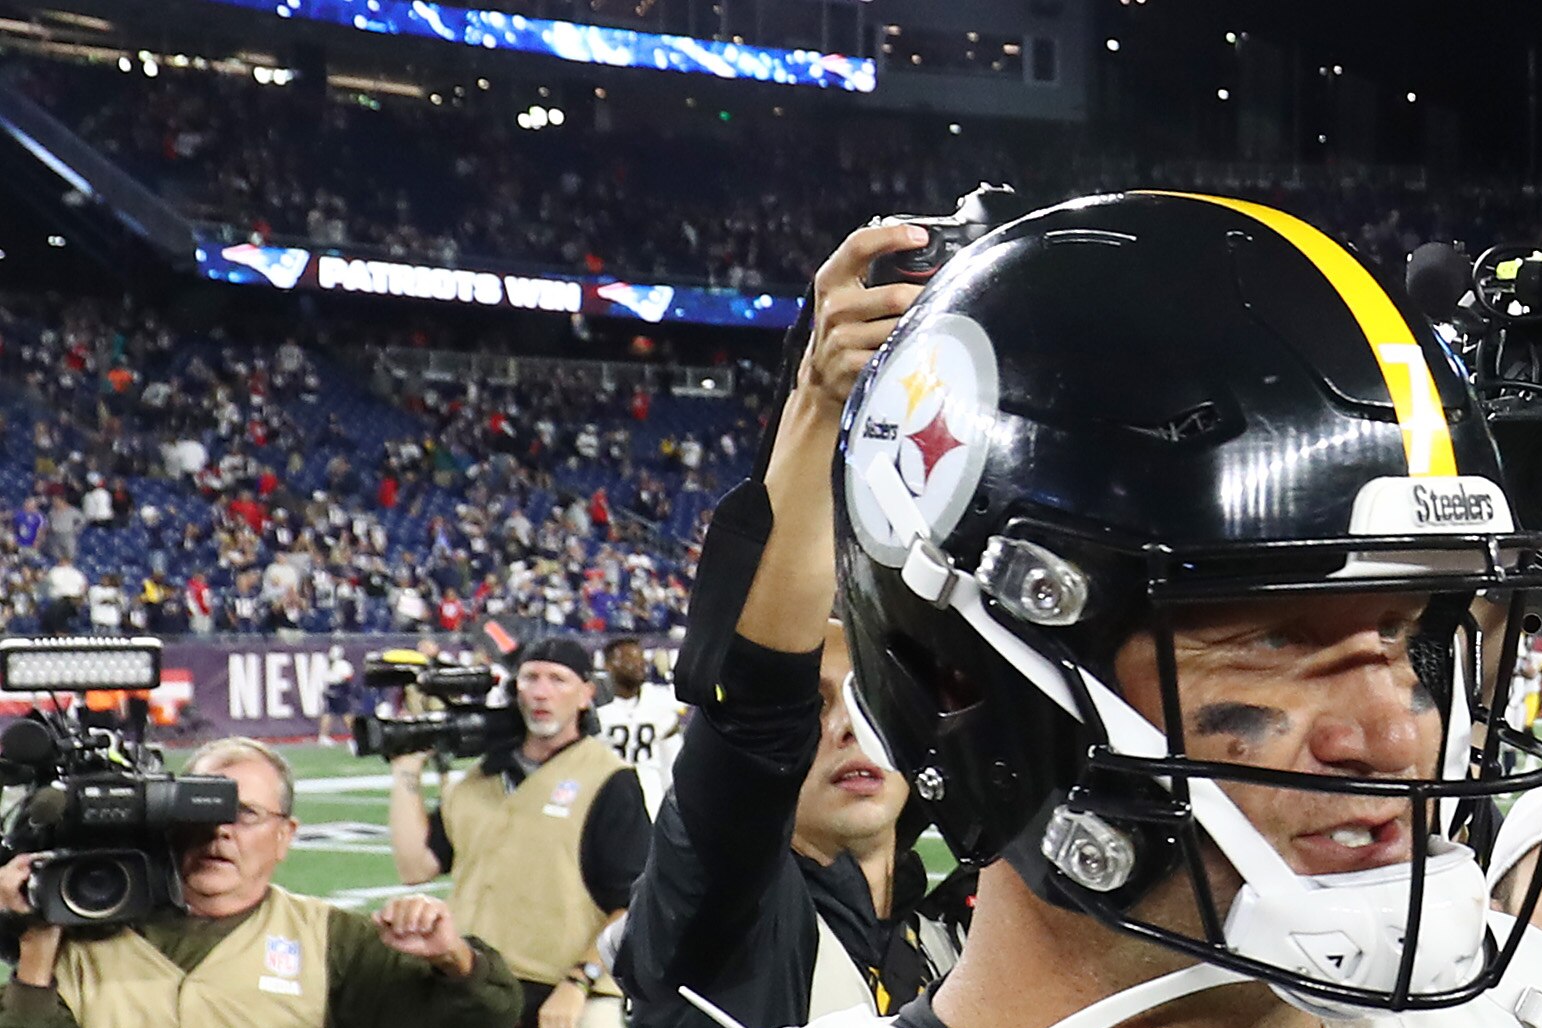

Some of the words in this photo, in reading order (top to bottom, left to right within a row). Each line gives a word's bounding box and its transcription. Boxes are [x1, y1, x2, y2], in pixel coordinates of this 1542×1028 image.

[318, 256, 502, 304] PATRIOTS
[504, 276, 582, 312] WIN
[1413, 484, 1494, 523] Steelers
